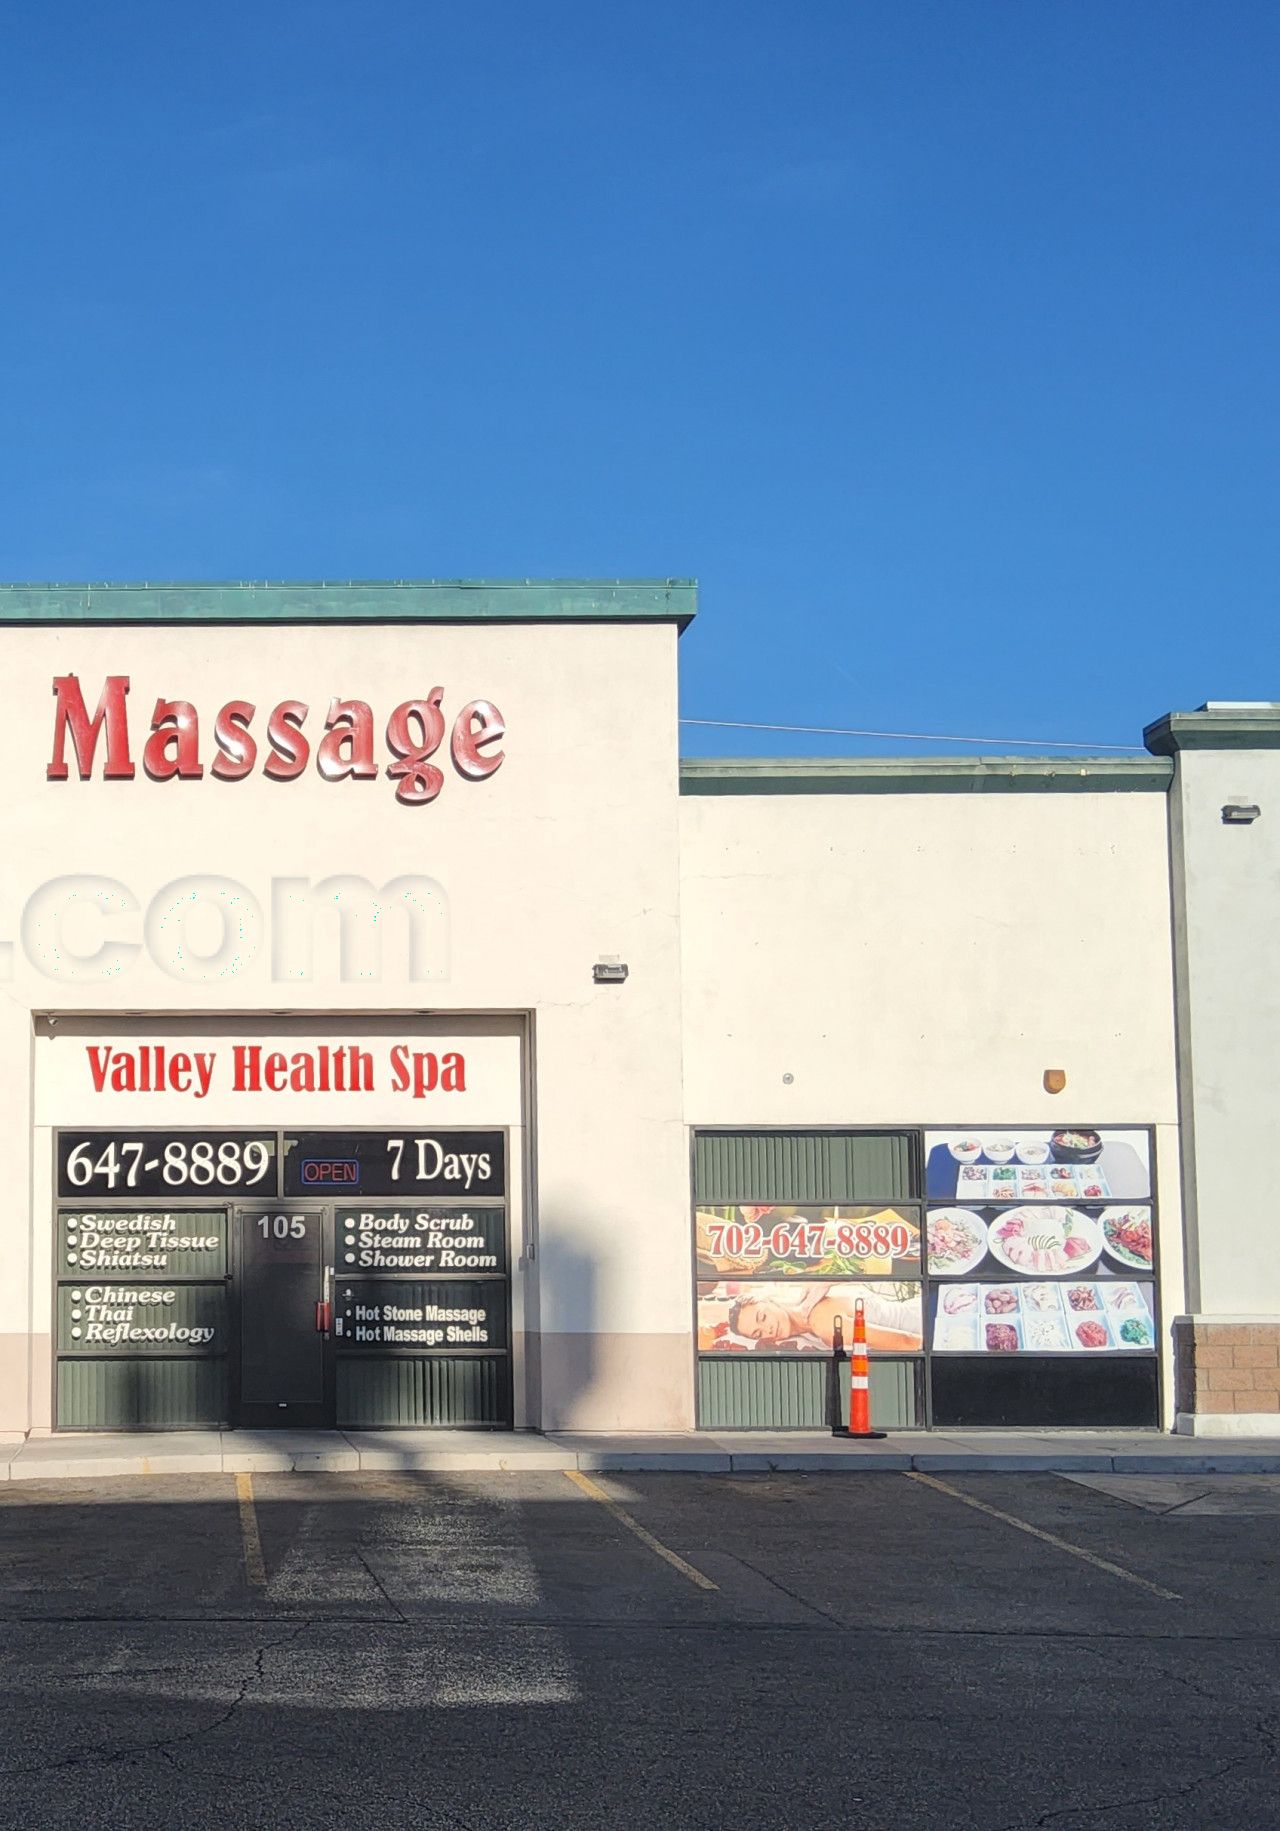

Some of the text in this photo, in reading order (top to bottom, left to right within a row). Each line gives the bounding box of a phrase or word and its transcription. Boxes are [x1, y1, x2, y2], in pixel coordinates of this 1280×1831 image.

[46, 674, 506, 804] Massage
[86, 1045, 467, 1099] Valley Health Spa
[66, 1141, 270, 1189] 647-8889
[304, 1163, 358, 1182] OPEN
[386, 1138, 492, 1190] 7 Days
[79, 1214, 177, 1232] Swedish
[257, 1215, 306, 1240] 105
[358, 1213, 474, 1234] Body Scrub
[79, 1232, 219, 1251] Deep Tissue
[358, 1231, 485, 1250] Steam Room
[707, 1223, 911, 1259] 702-647-8889
[79, 1249, 168, 1268] Shiatsu
[358, 1249, 498, 1268] Shower Room
[84, 1286, 176, 1304] Chinese
[85, 1305, 134, 1322] Thai
[355, 1306, 486, 1325] Hot Stone Massage
[84, 1322, 215, 1344] Reflexology
[355, 1327, 488, 1346] Hot Massage Shells
